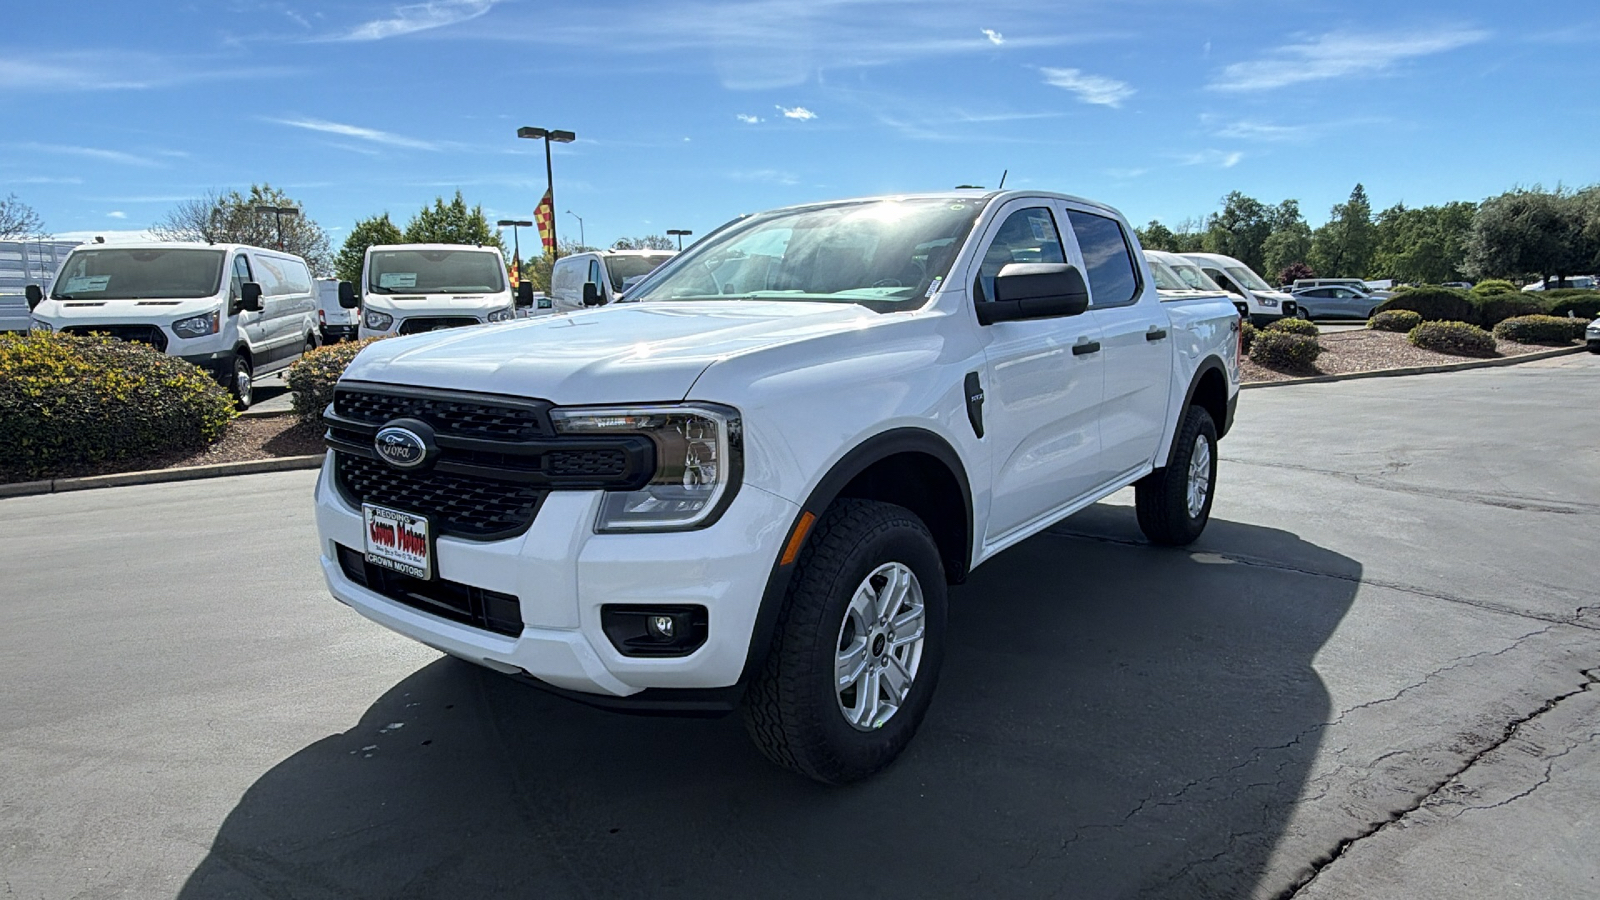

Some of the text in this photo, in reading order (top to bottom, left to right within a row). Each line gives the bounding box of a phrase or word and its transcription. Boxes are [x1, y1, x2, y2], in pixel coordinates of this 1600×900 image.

[383, 434, 411, 459] Ford
[376, 509, 410, 523] REDDING
[368, 553, 424, 578] CROWN MOTORS
